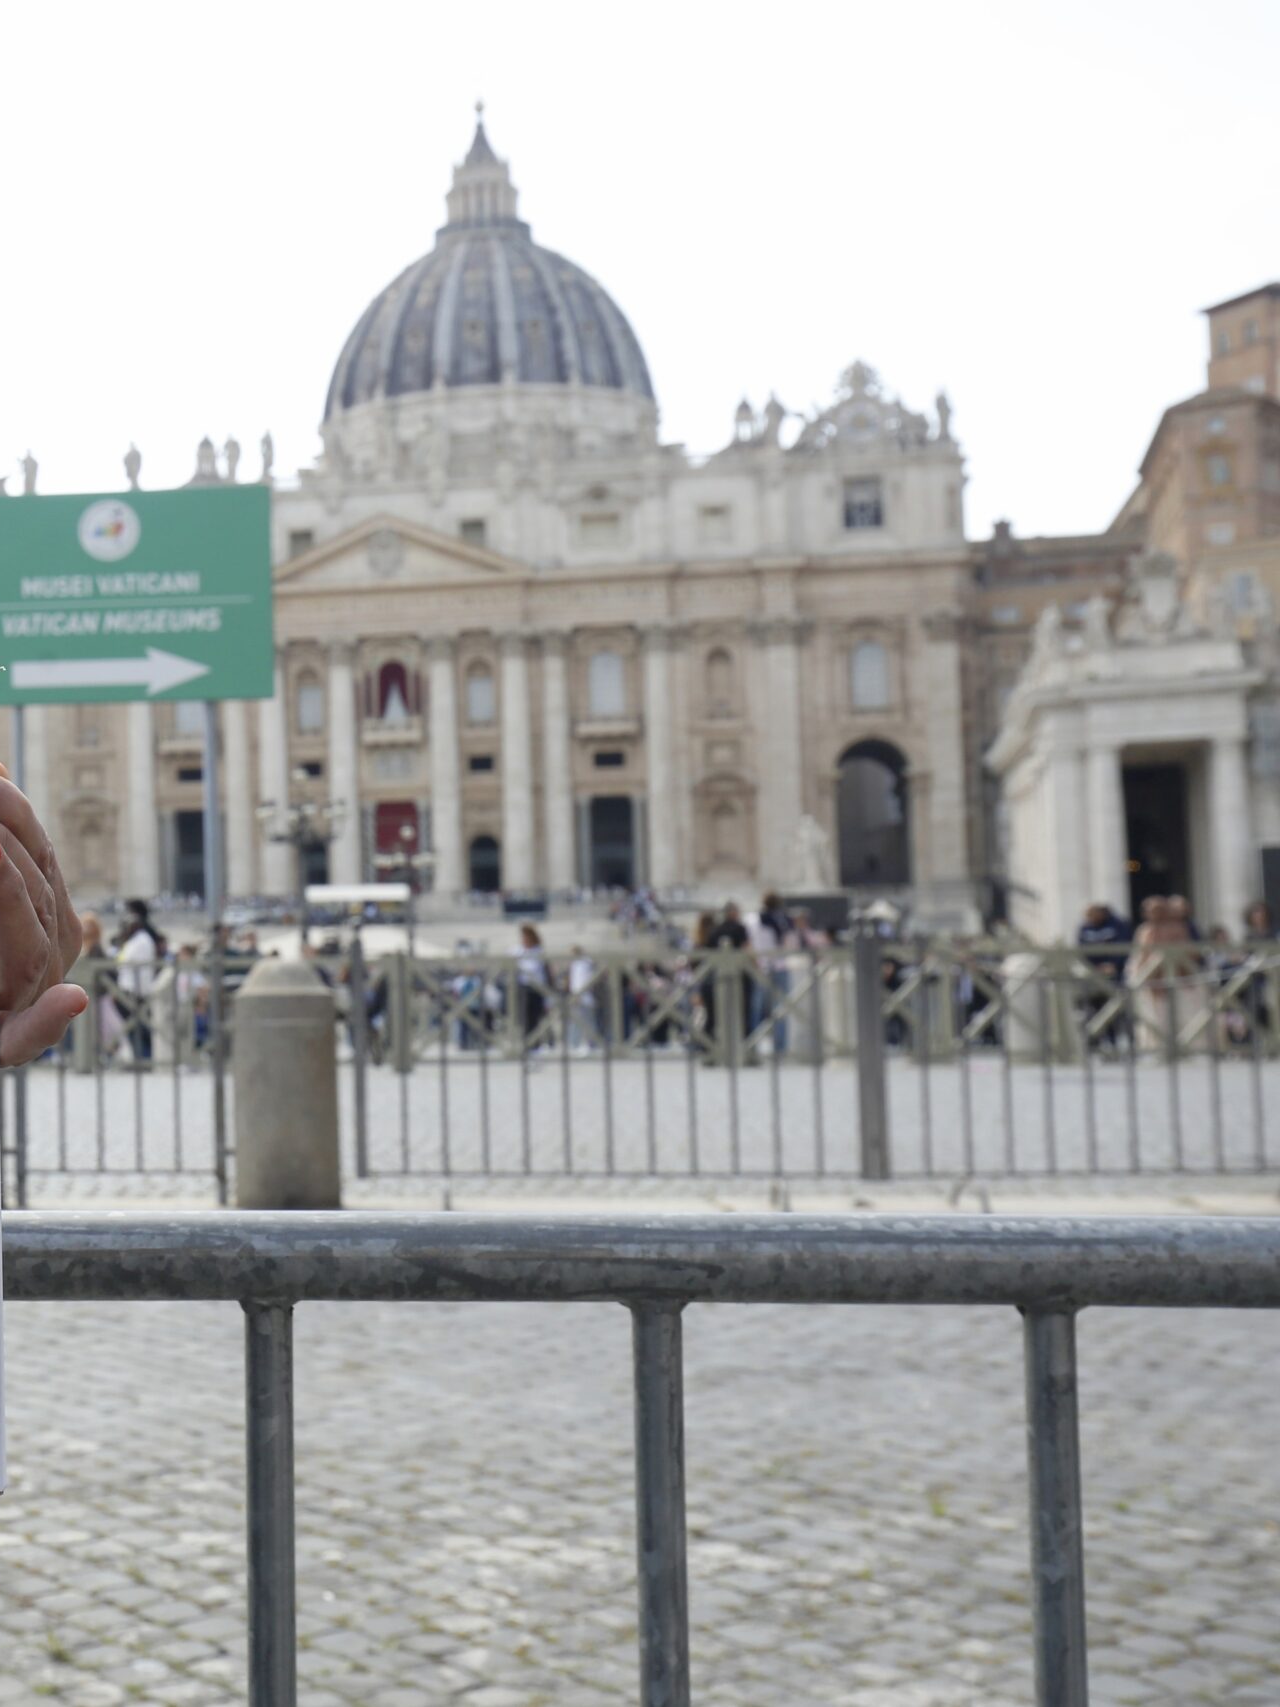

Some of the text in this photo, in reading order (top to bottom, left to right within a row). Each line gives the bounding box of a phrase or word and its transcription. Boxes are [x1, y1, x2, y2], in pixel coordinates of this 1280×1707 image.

[20, 570, 201, 599] MUSEI VATICANI
[1, 606, 223, 637] VATICAN MUSEUMS
